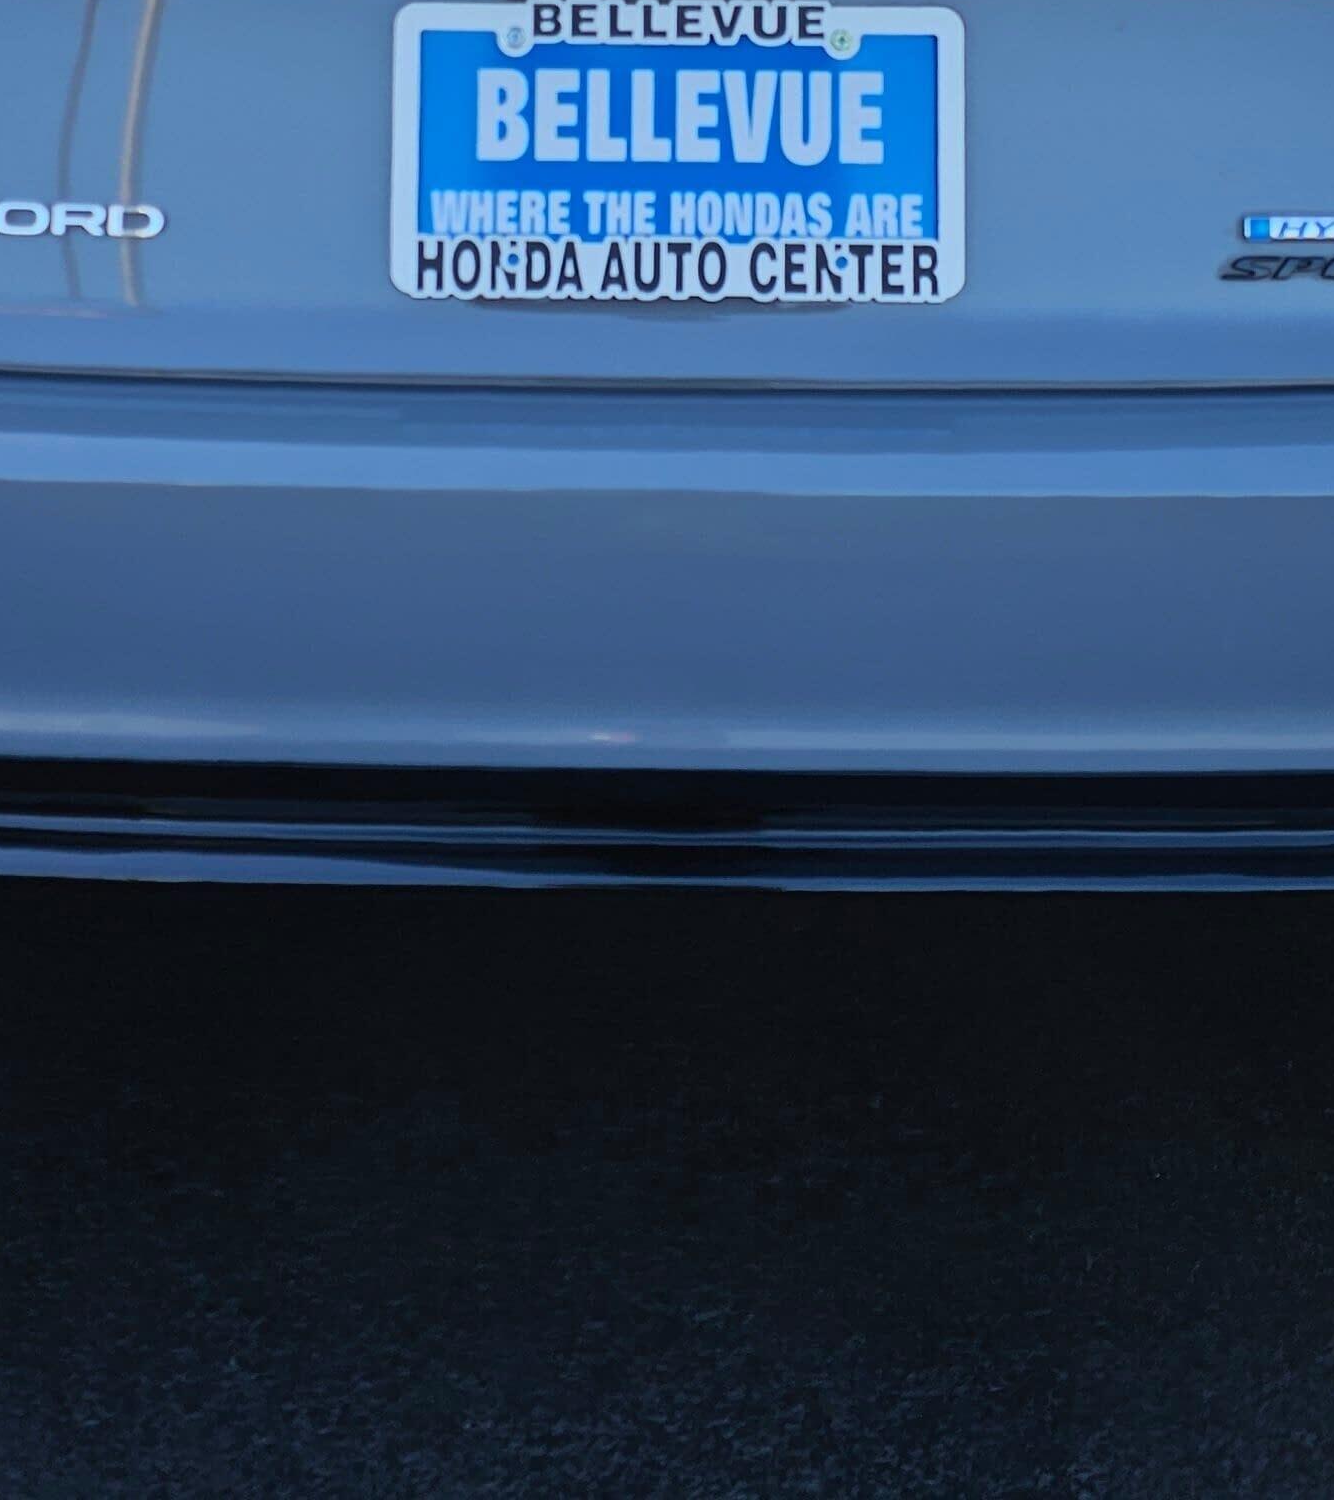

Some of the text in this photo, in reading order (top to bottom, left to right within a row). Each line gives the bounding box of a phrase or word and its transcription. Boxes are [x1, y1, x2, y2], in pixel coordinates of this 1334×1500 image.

[531, 3, 826, 39] BELLEVUE
[476, 67, 885, 166] BELLEVUE
[430, 191, 924, 238] WHERE THE HONDAS ARE
[417, 240, 940, 296] HONDA AUTO CENTER
